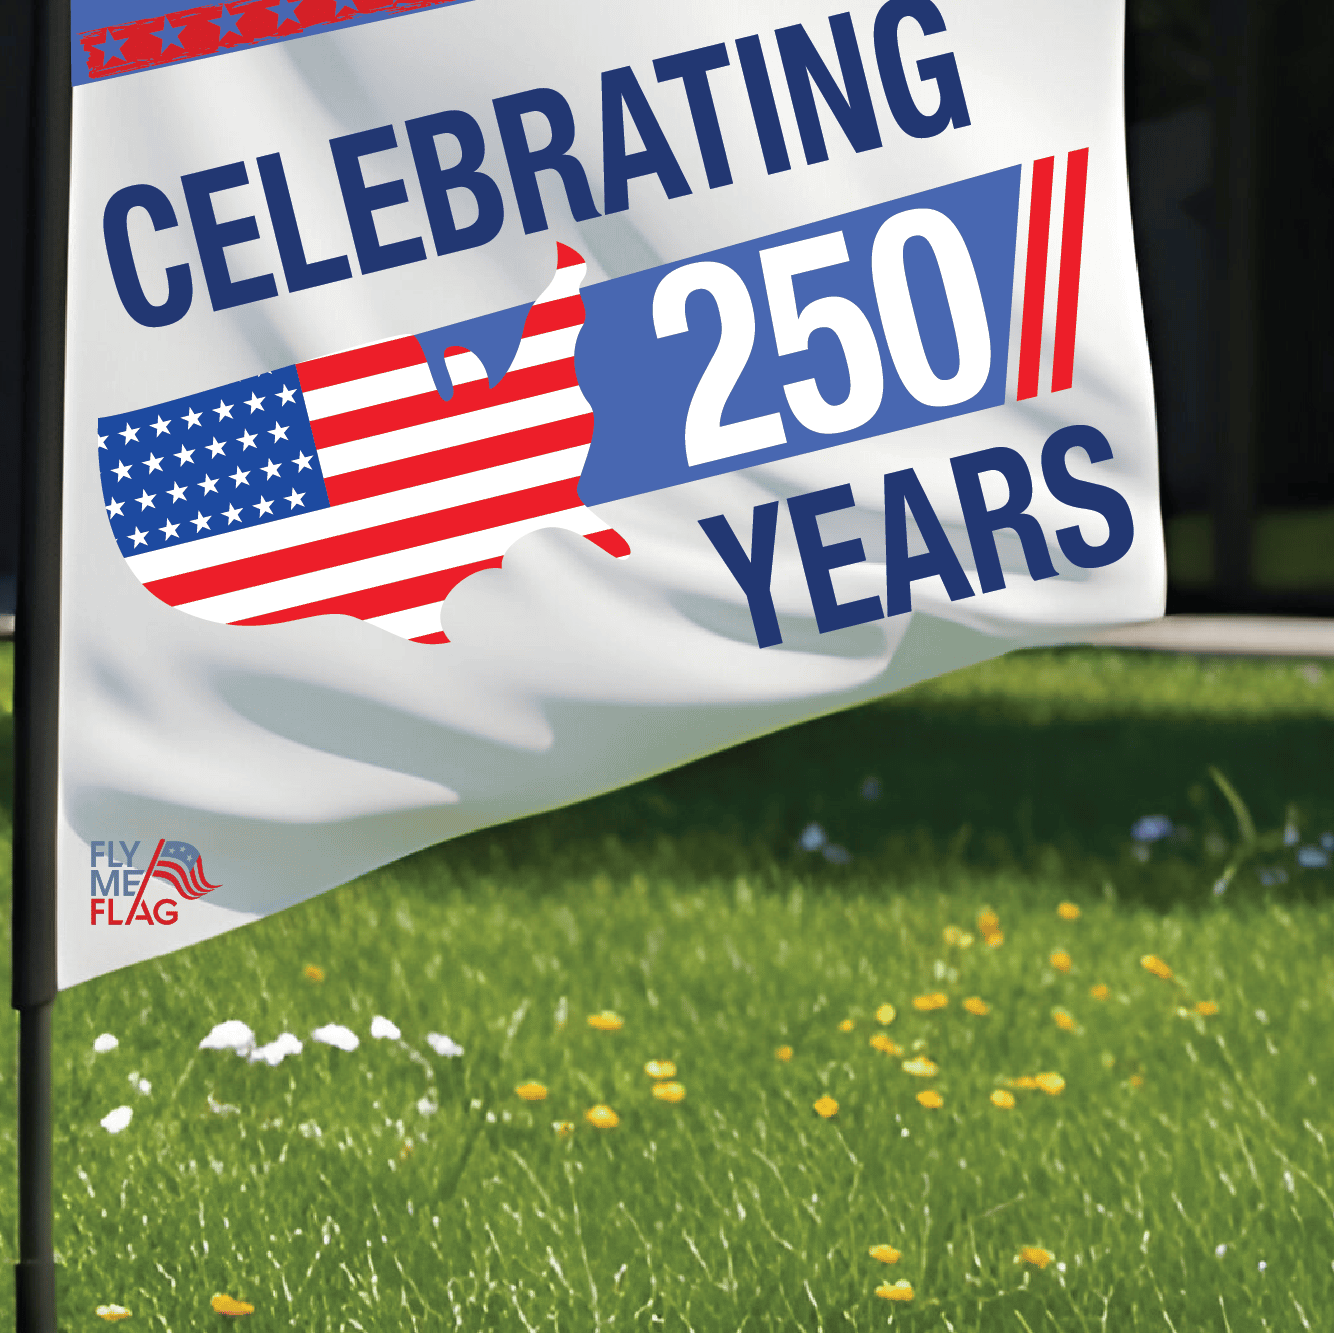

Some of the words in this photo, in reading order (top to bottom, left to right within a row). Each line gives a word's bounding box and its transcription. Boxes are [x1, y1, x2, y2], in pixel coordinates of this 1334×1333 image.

[652, 208, 992, 468] 250
[697, 424, 1135, 649] YEARS
[90, 840, 141, 868] FLY
[90, 869, 145, 897] ME
[90, 898, 179, 925] FLAG
